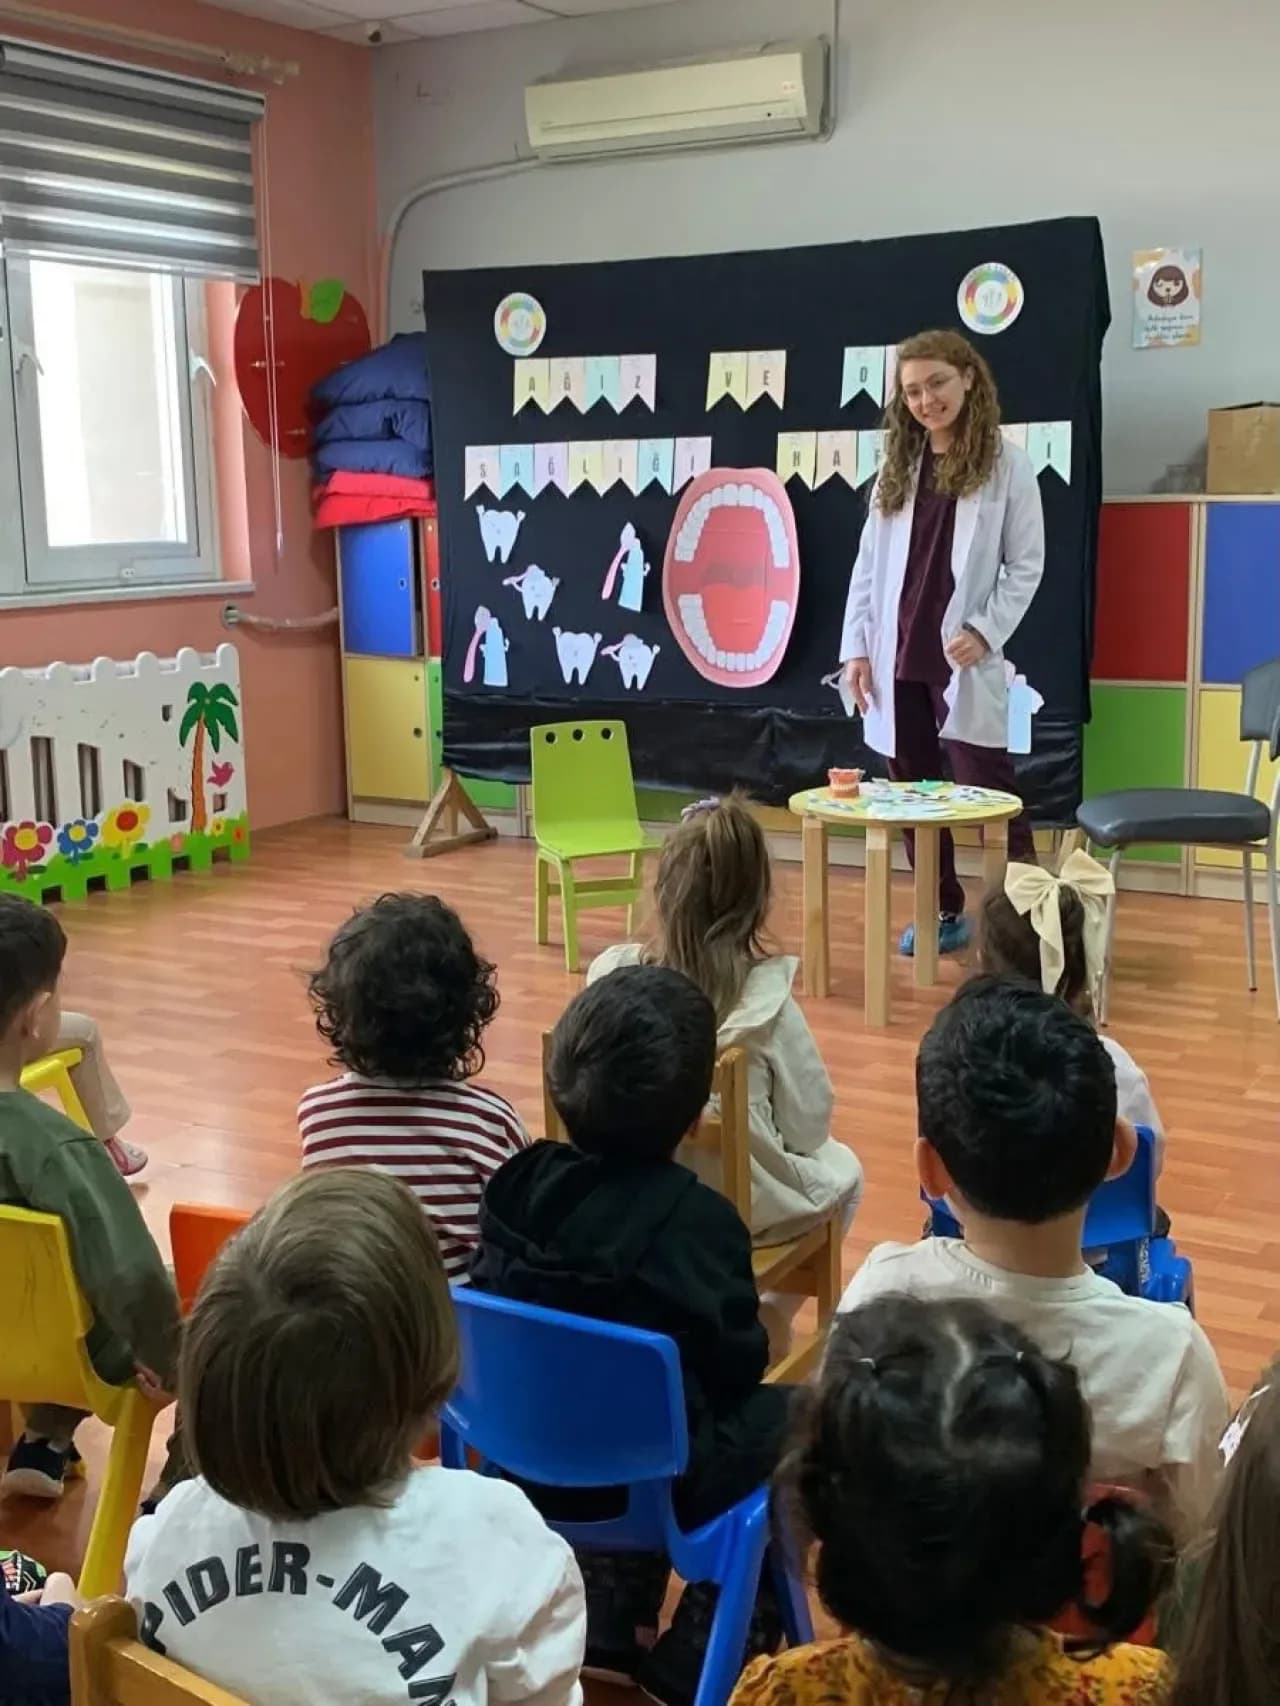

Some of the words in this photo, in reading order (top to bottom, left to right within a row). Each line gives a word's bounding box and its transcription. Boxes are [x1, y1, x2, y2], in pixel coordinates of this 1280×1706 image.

[528, 372, 641, 391] AĞIZ
[724, 370, 770, 388] VE
[479, 453, 694, 478] SAĞLIĞI
